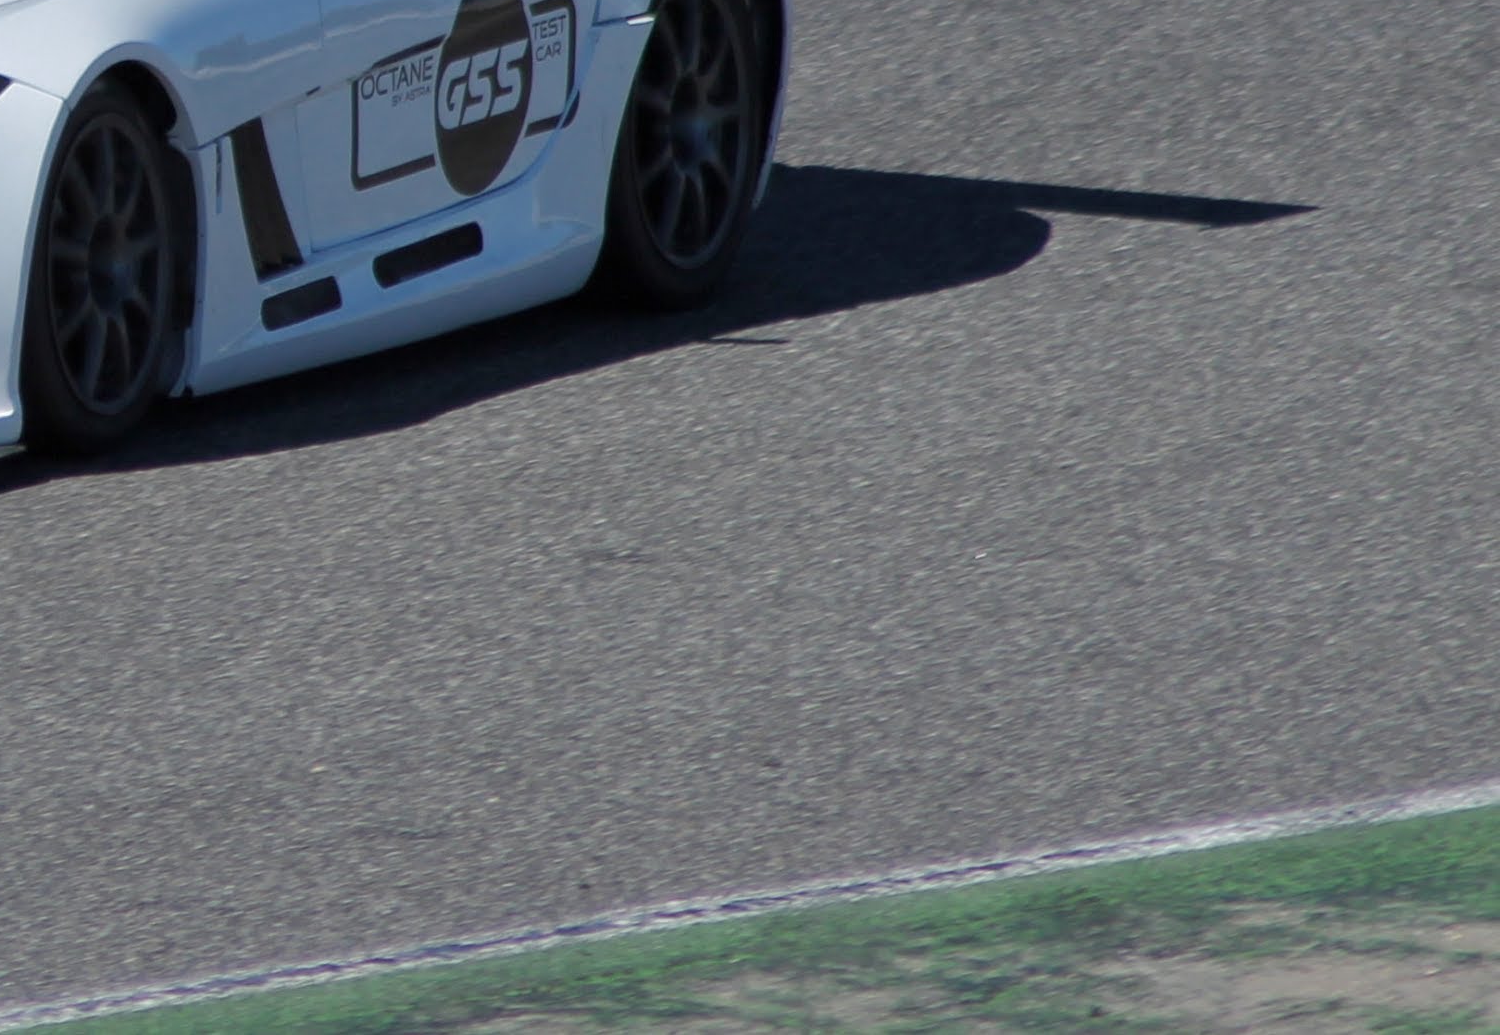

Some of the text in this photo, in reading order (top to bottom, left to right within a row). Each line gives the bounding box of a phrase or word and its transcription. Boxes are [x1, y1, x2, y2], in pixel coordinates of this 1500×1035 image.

[531, 15, 567, 41] TEST
[535, 42, 562, 62] CAR
[360, 55, 435, 101] OCTANE
